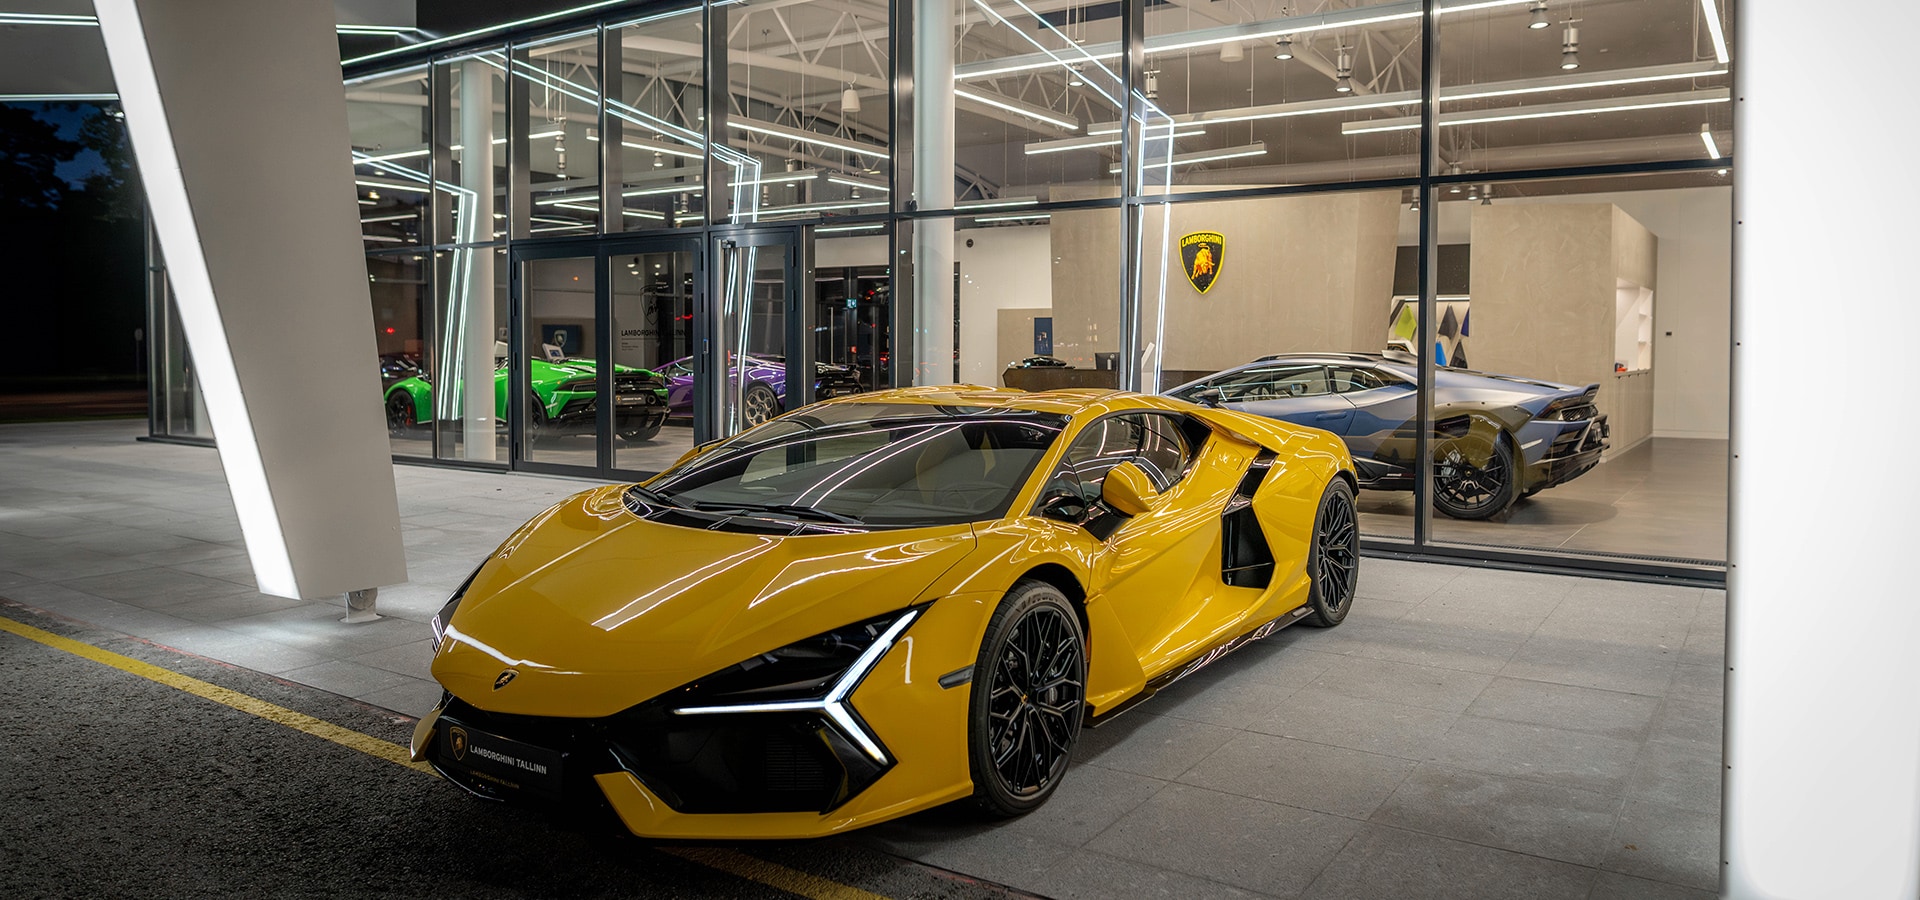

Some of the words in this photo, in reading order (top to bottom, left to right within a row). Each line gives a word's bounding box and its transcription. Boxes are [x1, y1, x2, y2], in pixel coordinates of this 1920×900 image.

[1181, 234, 1222, 248] LAMBORGHINI
[469, 744, 515, 766] LAMBORGHINI
[516, 758, 547, 775] TALLINN
